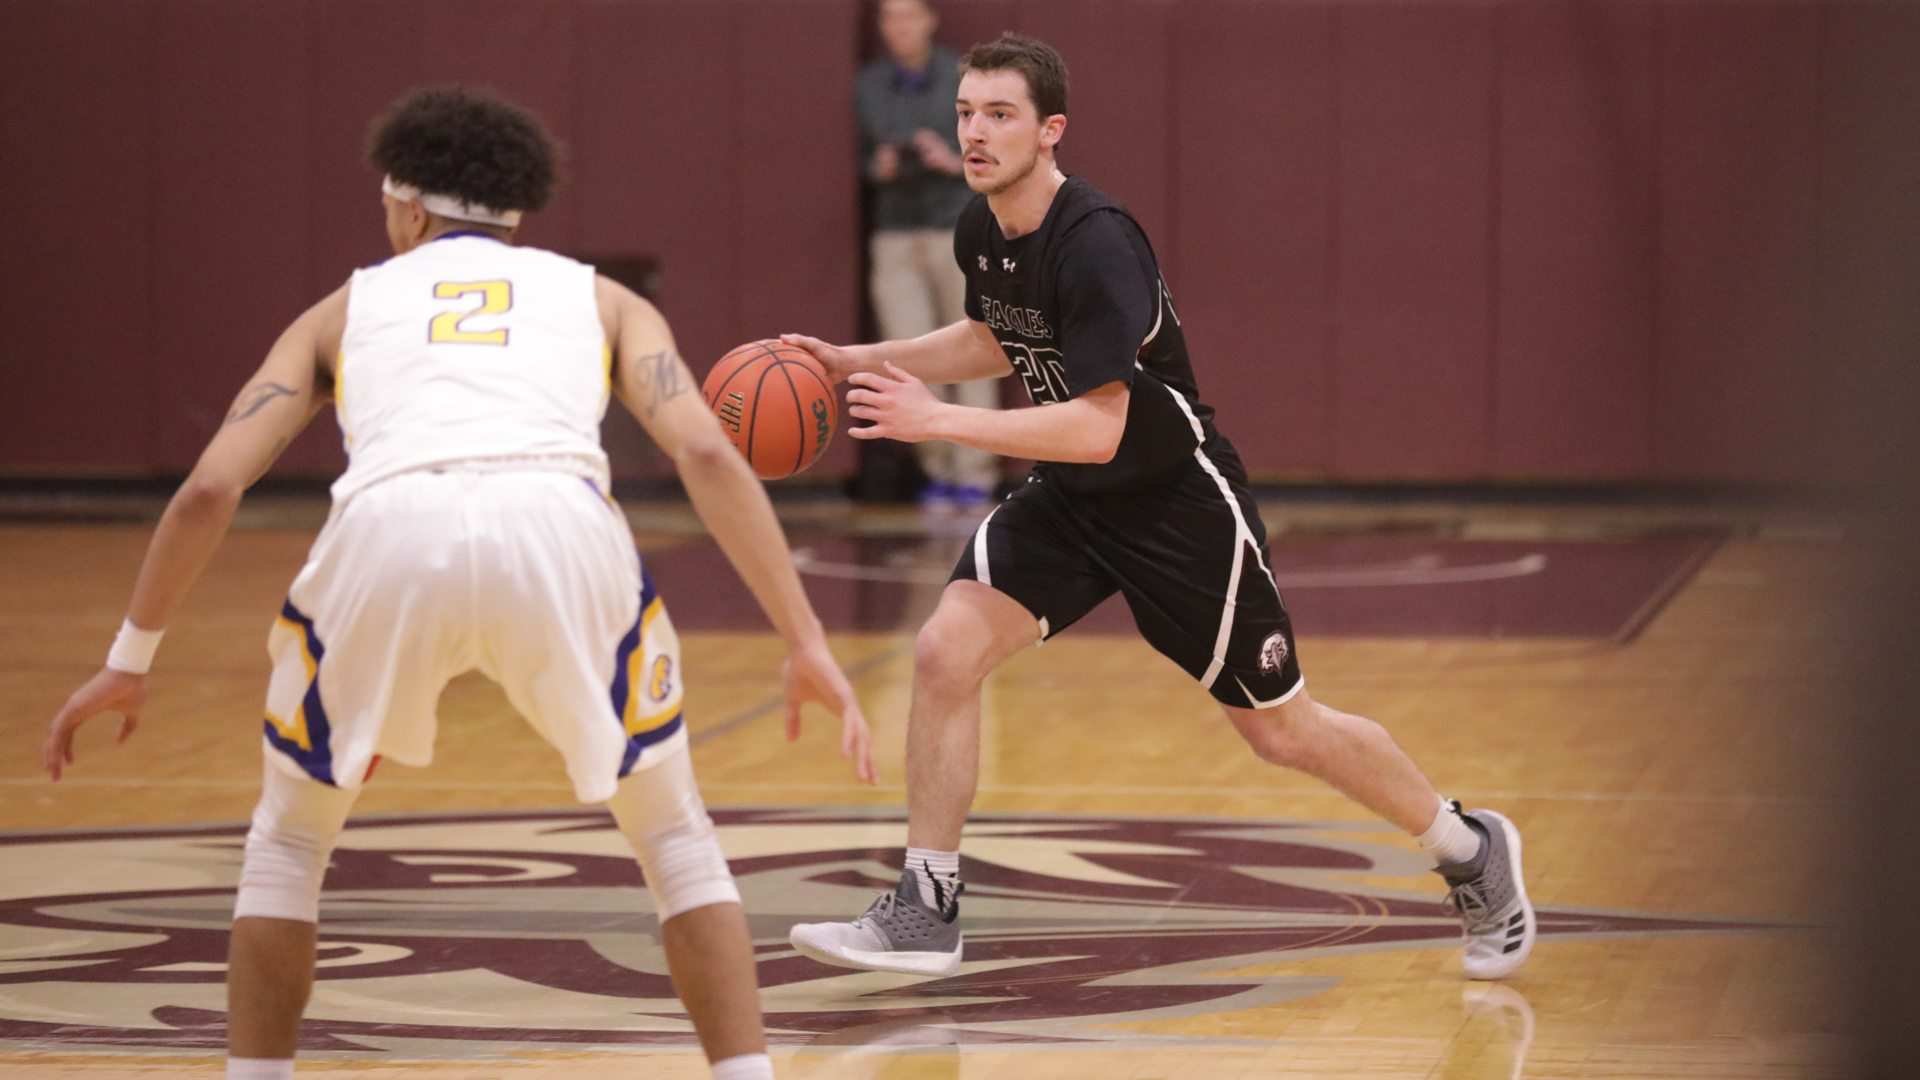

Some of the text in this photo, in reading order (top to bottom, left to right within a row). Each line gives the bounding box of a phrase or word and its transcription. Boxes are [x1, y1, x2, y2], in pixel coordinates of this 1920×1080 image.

[428, 279, 513, 347] 2
[981, 295, 1054, 339] EAGLES
[718, 390, 745, 434] THE
